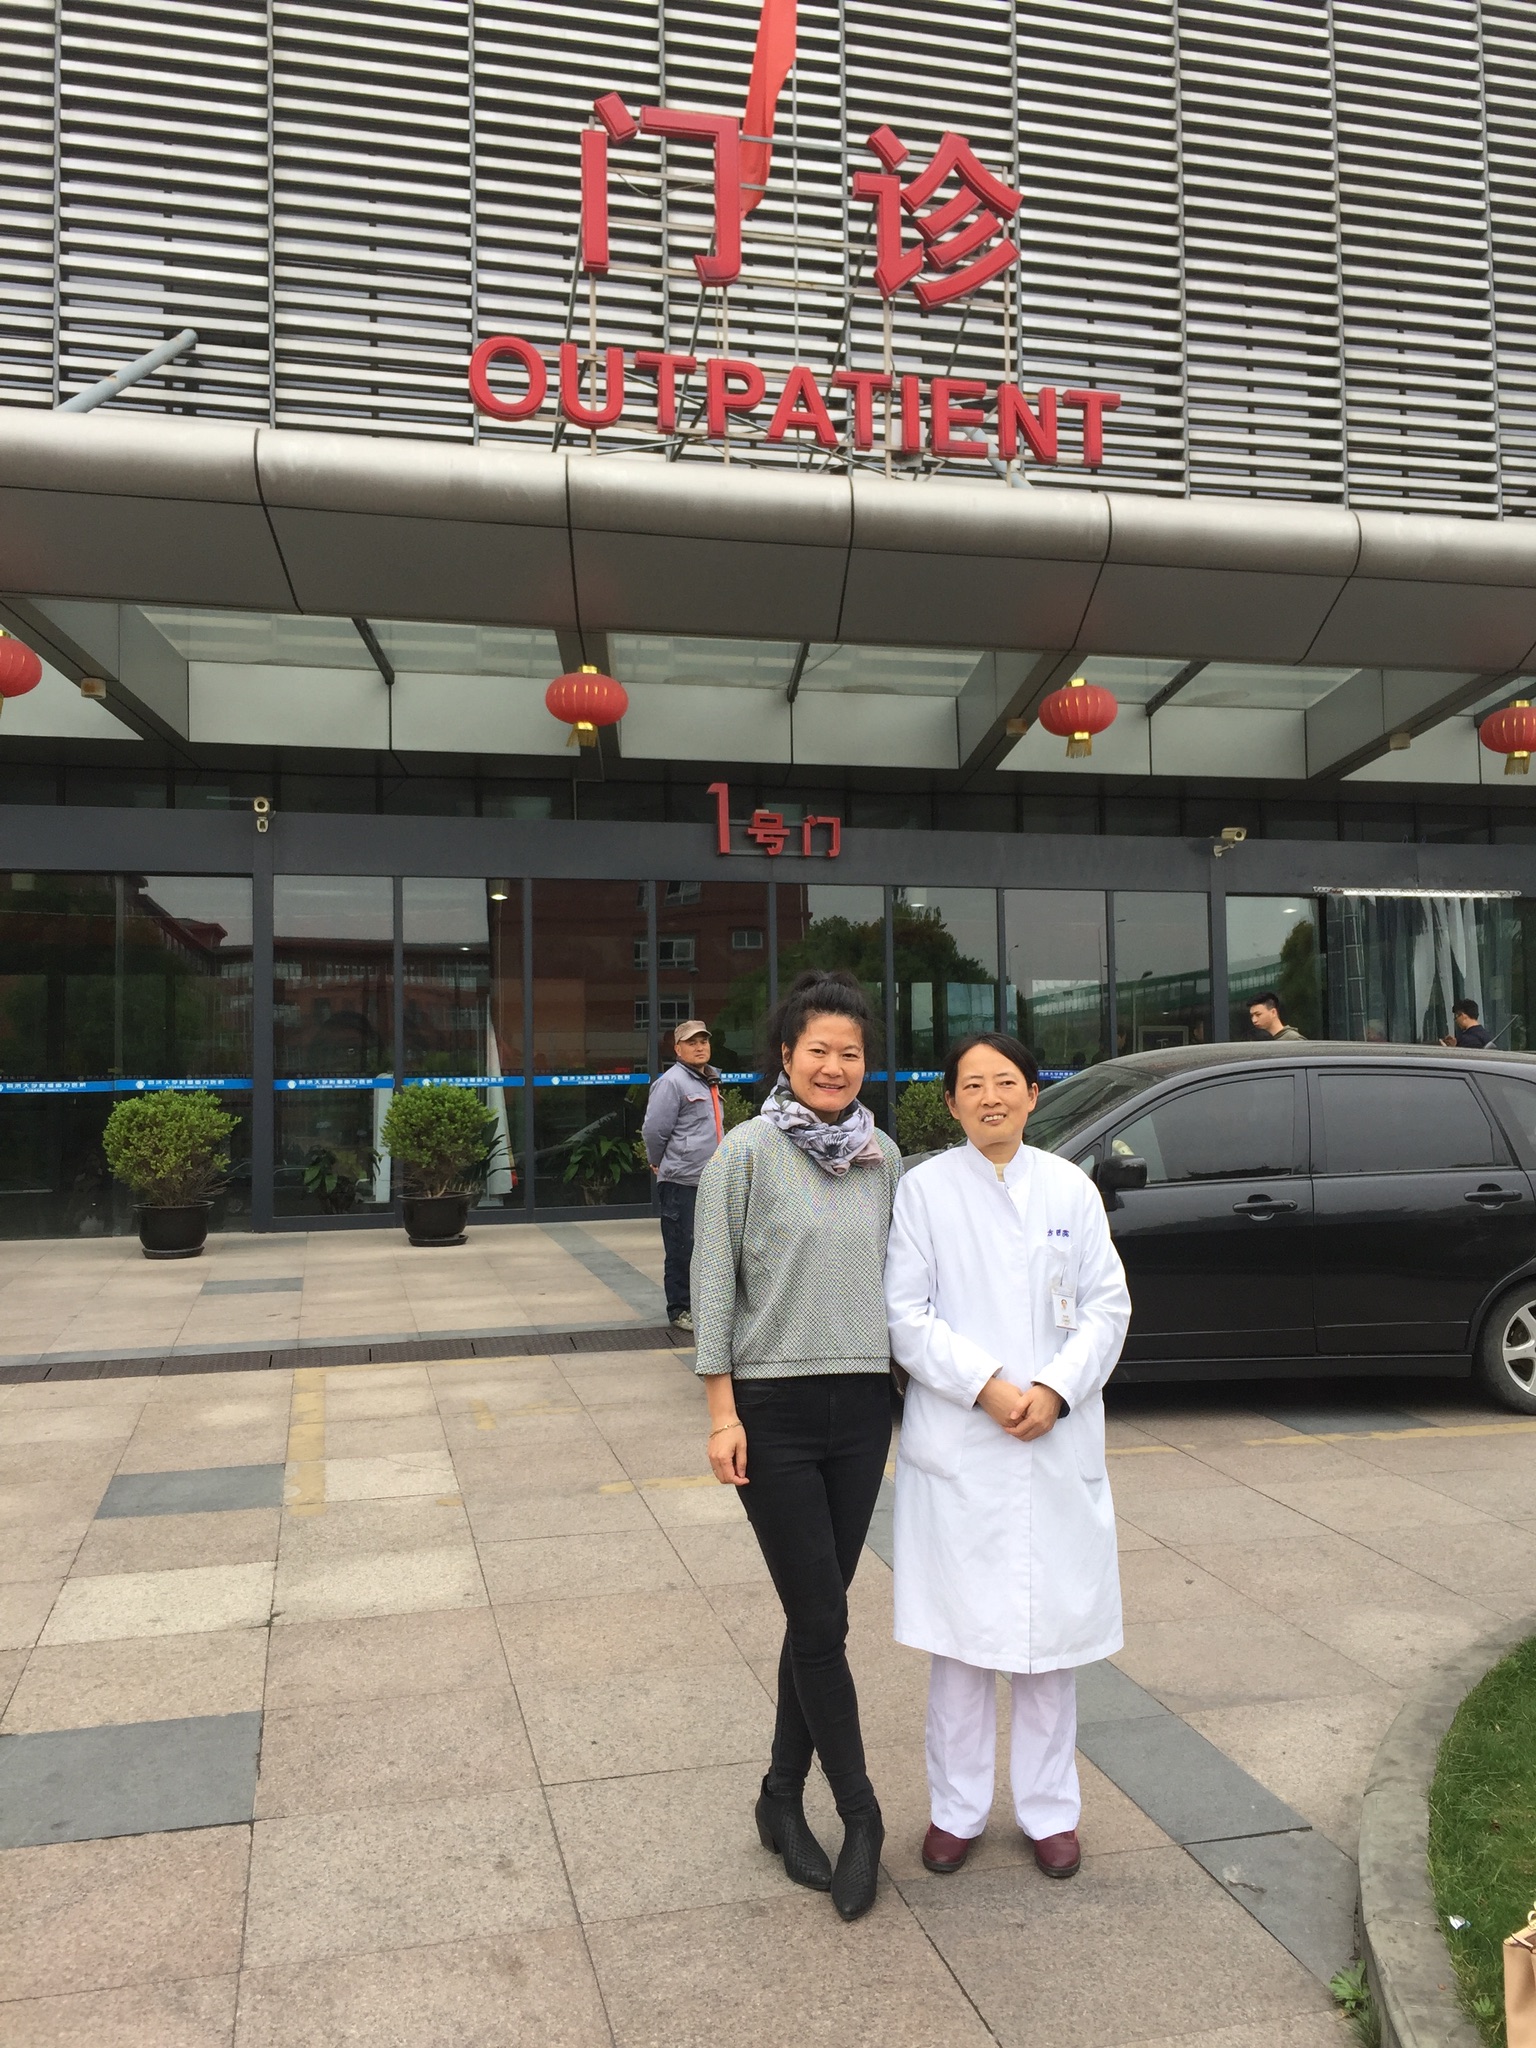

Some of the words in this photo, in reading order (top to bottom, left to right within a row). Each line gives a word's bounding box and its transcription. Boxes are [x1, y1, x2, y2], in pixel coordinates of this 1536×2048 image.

[580, 91, 1022, 310] 门诊
[468, 335, 1121, 467] OUTPATIENT
[706, 782, 841, 858] 1号门
